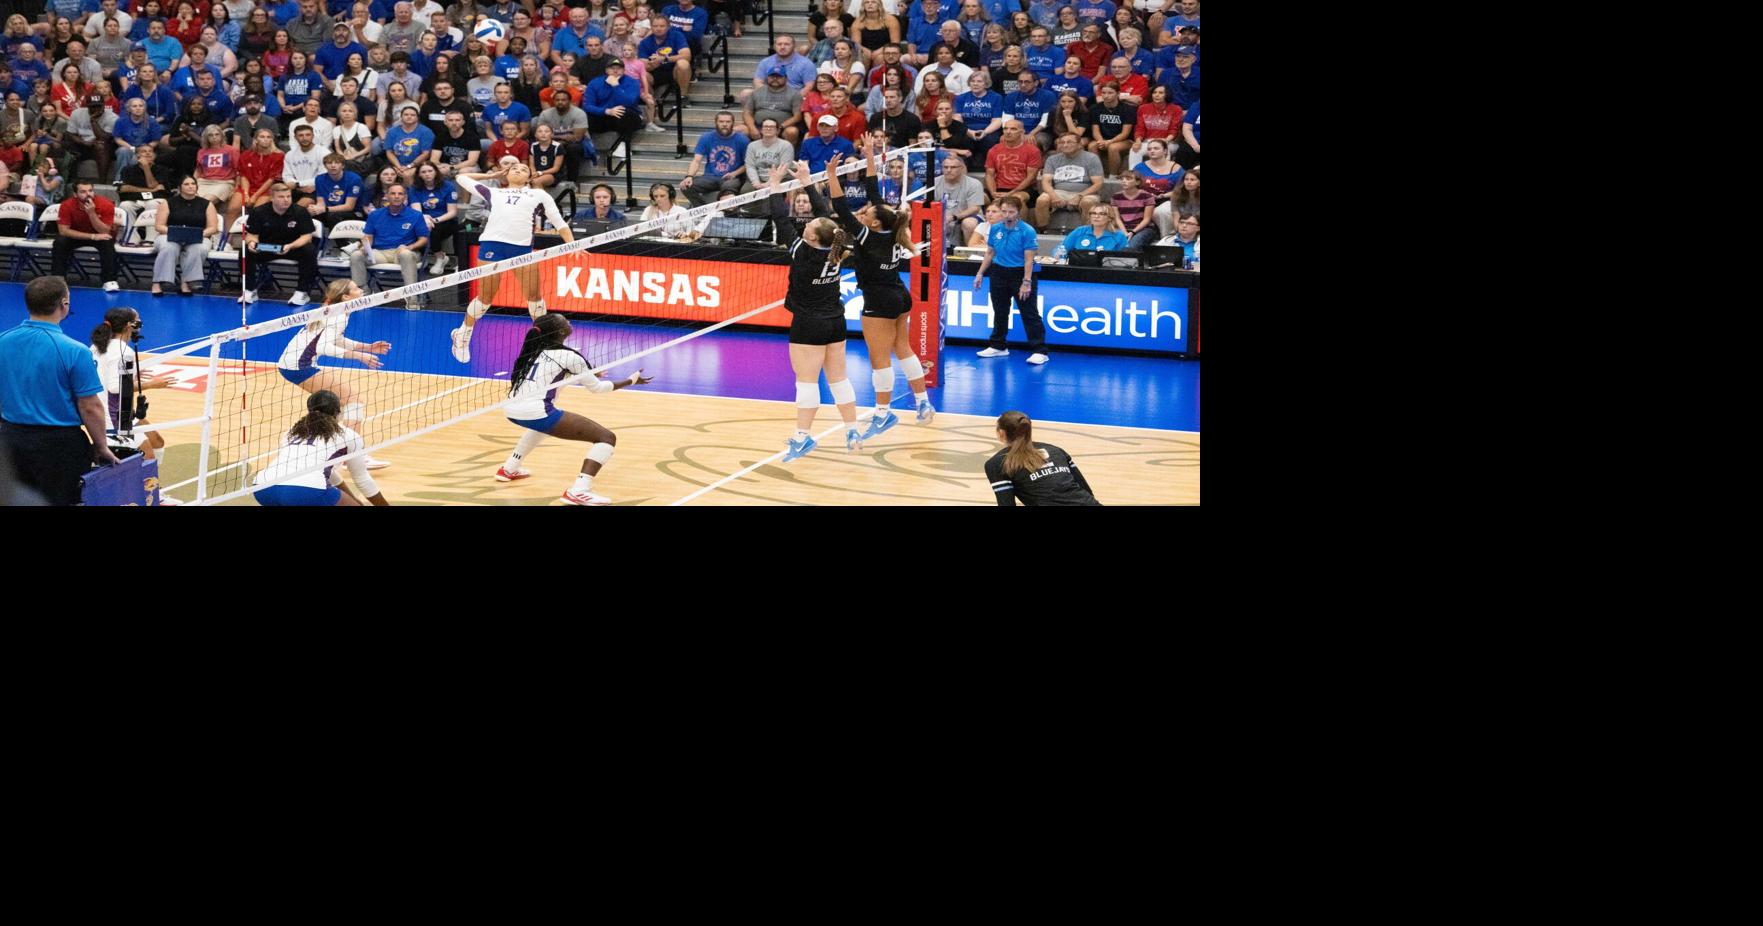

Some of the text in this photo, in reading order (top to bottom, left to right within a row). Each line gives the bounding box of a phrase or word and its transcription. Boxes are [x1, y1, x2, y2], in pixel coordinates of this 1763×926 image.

[1054, 31, 1081, 40] KANSAS
[1100, 114, 1121, 124] PVA
[506, 195, 521, 205] 17
[819, 260, 840, 278] 13
[557, 266, 720, 307] KANSAS
[280, 313, 310, 328] KANSAS
[920, 311, 929, 357] sports imports
[1029, 465, 1071, 482] BLUEJAYS
